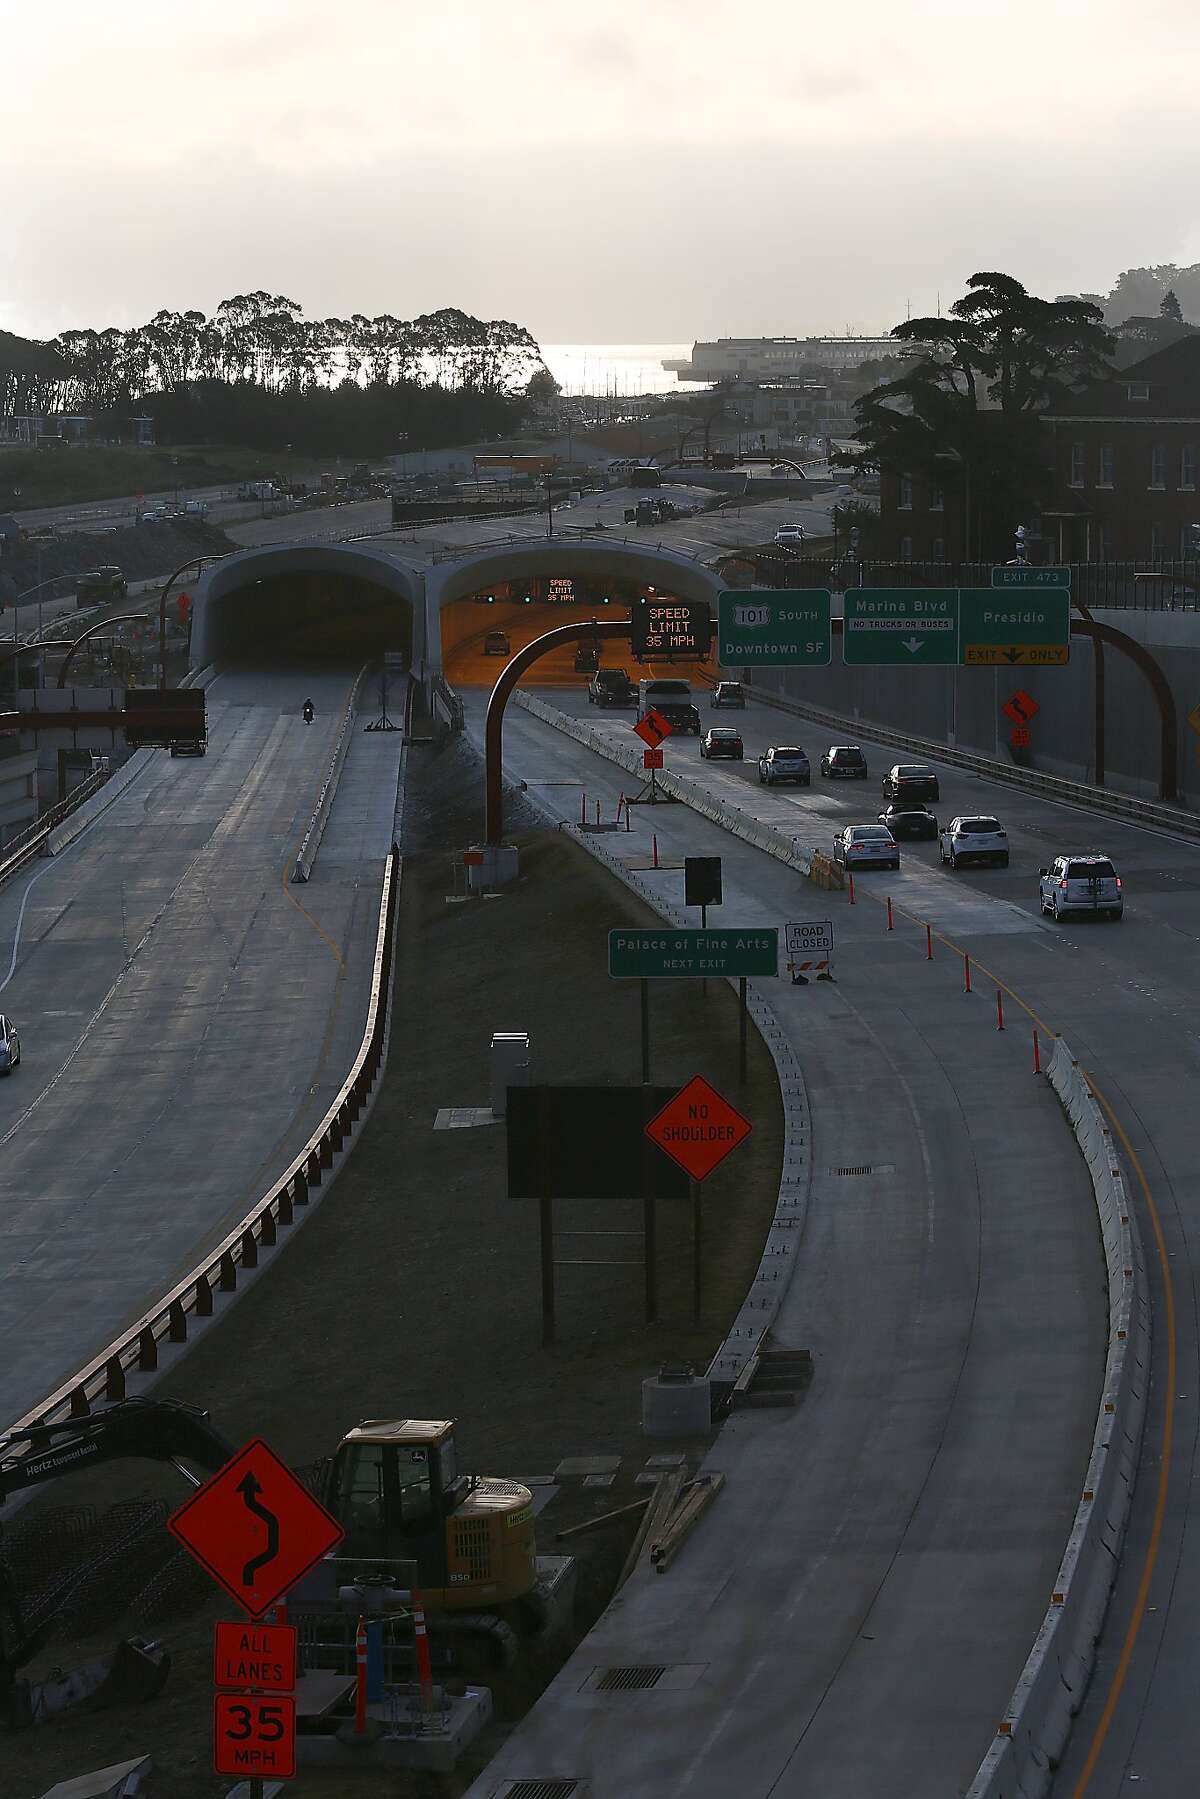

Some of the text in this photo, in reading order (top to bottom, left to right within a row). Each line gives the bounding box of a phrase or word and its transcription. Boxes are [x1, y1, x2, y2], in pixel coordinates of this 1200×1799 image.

[1003, 573, 1059, 581] EXIT 473
[856, 600, 947, 612] Marina Blvd
[649, 607, 690, 619] SPEED
[741, 610, 818, 622] 101 SOUTH
[983, 612, 1044, 623] Presidio
[649, 621, 690, 633] LIMIT
[645, 635, 695, 647] 35 MPH
[725, 642, 824, 654] Downtown SF
[967, 648, 1063, 660] EXIT ONLY
[794, 926, 824, 937] ROAD
[616, 938, 769, 950] Palace of Fine Arts
[790, 938, 829, 949] CLOSED
[663, 959, 726, 968] NEXT EXIT
[688, 1104, 709, 1119] NO
[663, 1126, 735, 1141] SHOULDER
[26, 1460, 53, 1477] Hertz
[240, 1633, 273, 1653] ALL
[226, 1660, 284, 1682] LANES
[225, 1704, 284, 1742] 35
[234, 1749, 277, 1767] MPH
